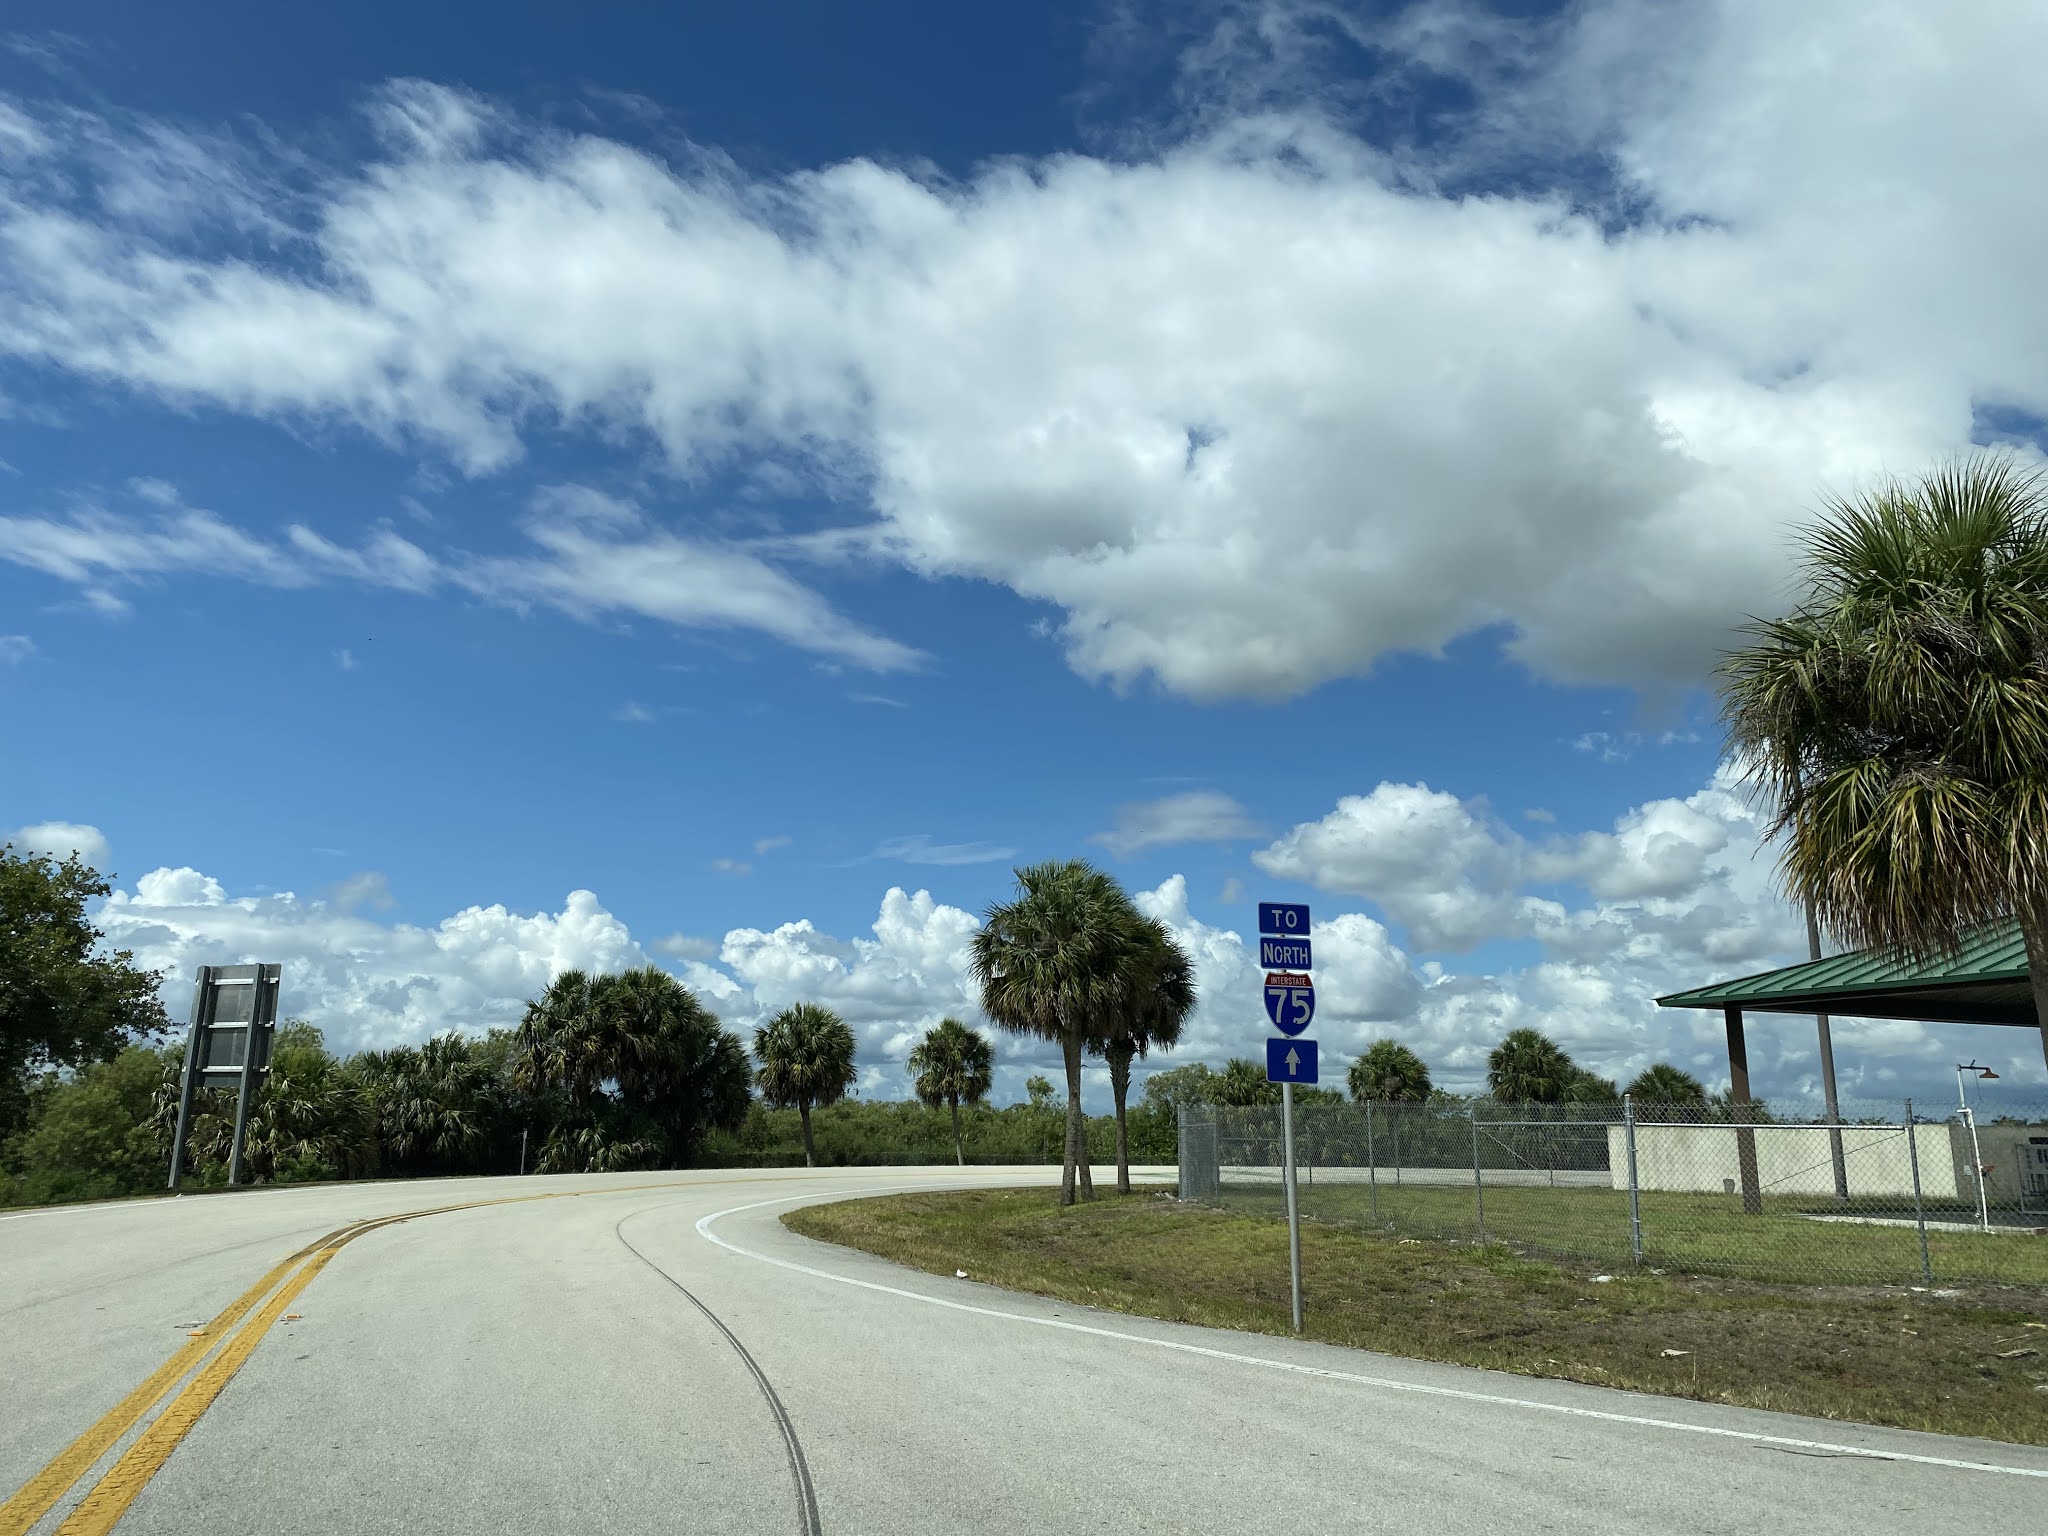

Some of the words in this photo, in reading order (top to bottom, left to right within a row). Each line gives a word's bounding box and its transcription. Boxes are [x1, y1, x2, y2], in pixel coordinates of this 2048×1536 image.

[1272, 910, 1297, 928] TO
[1264, 943, 1309, 965] NORTH
[1270, 976, 1306, 986] INTERSTATE
[1269, 989, 1311, 1024] 75
